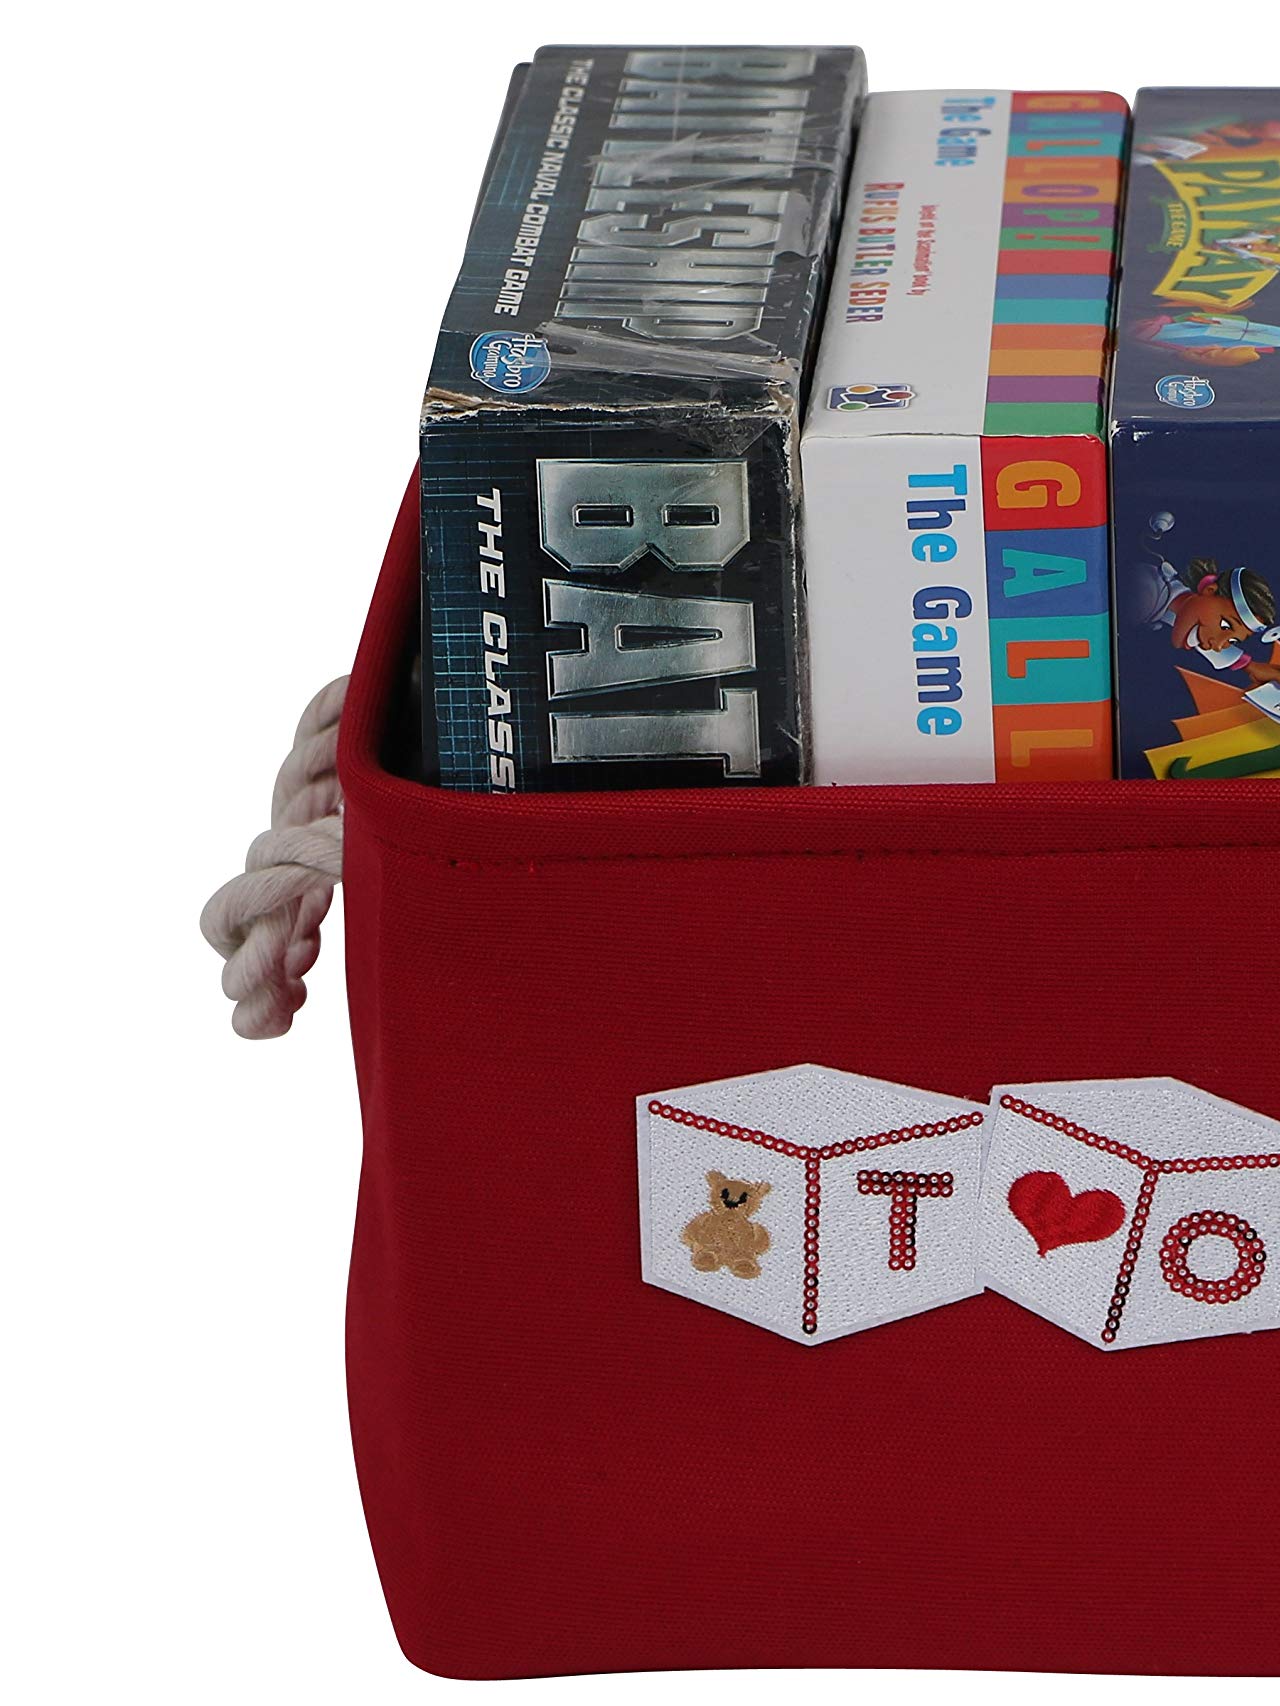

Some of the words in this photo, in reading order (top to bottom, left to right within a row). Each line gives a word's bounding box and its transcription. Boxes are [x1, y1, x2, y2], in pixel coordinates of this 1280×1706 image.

[565, 59, 594, 85] THE
[546, 86, 584, 149] CLASSIC
[940, 96, 996, 122] The
[934, 127, 991, 167] Game
[530, 151, 566, 200] NAVAL
[555, 51, 817, 340] BATTLESHIP
[859, 181, 905, 223] RUFUS
[510, 204, 549, 267] COMBAT
[850, 227, 896, 276] BUTLER
[494, 268, 529, 317] GAME
[845, 280, 890, 324] SEDER
[475, 340, 512, 381] Gaming
[501, 333, 544, 388] Hasbro
[1179, 376, 1208, 407] Hasbro
[906, 463, 968, 563] The
[476, 487, 506, 598] THE
[912, 585, 973, 736] Game
[483, 611, 516, 794] CLASS
